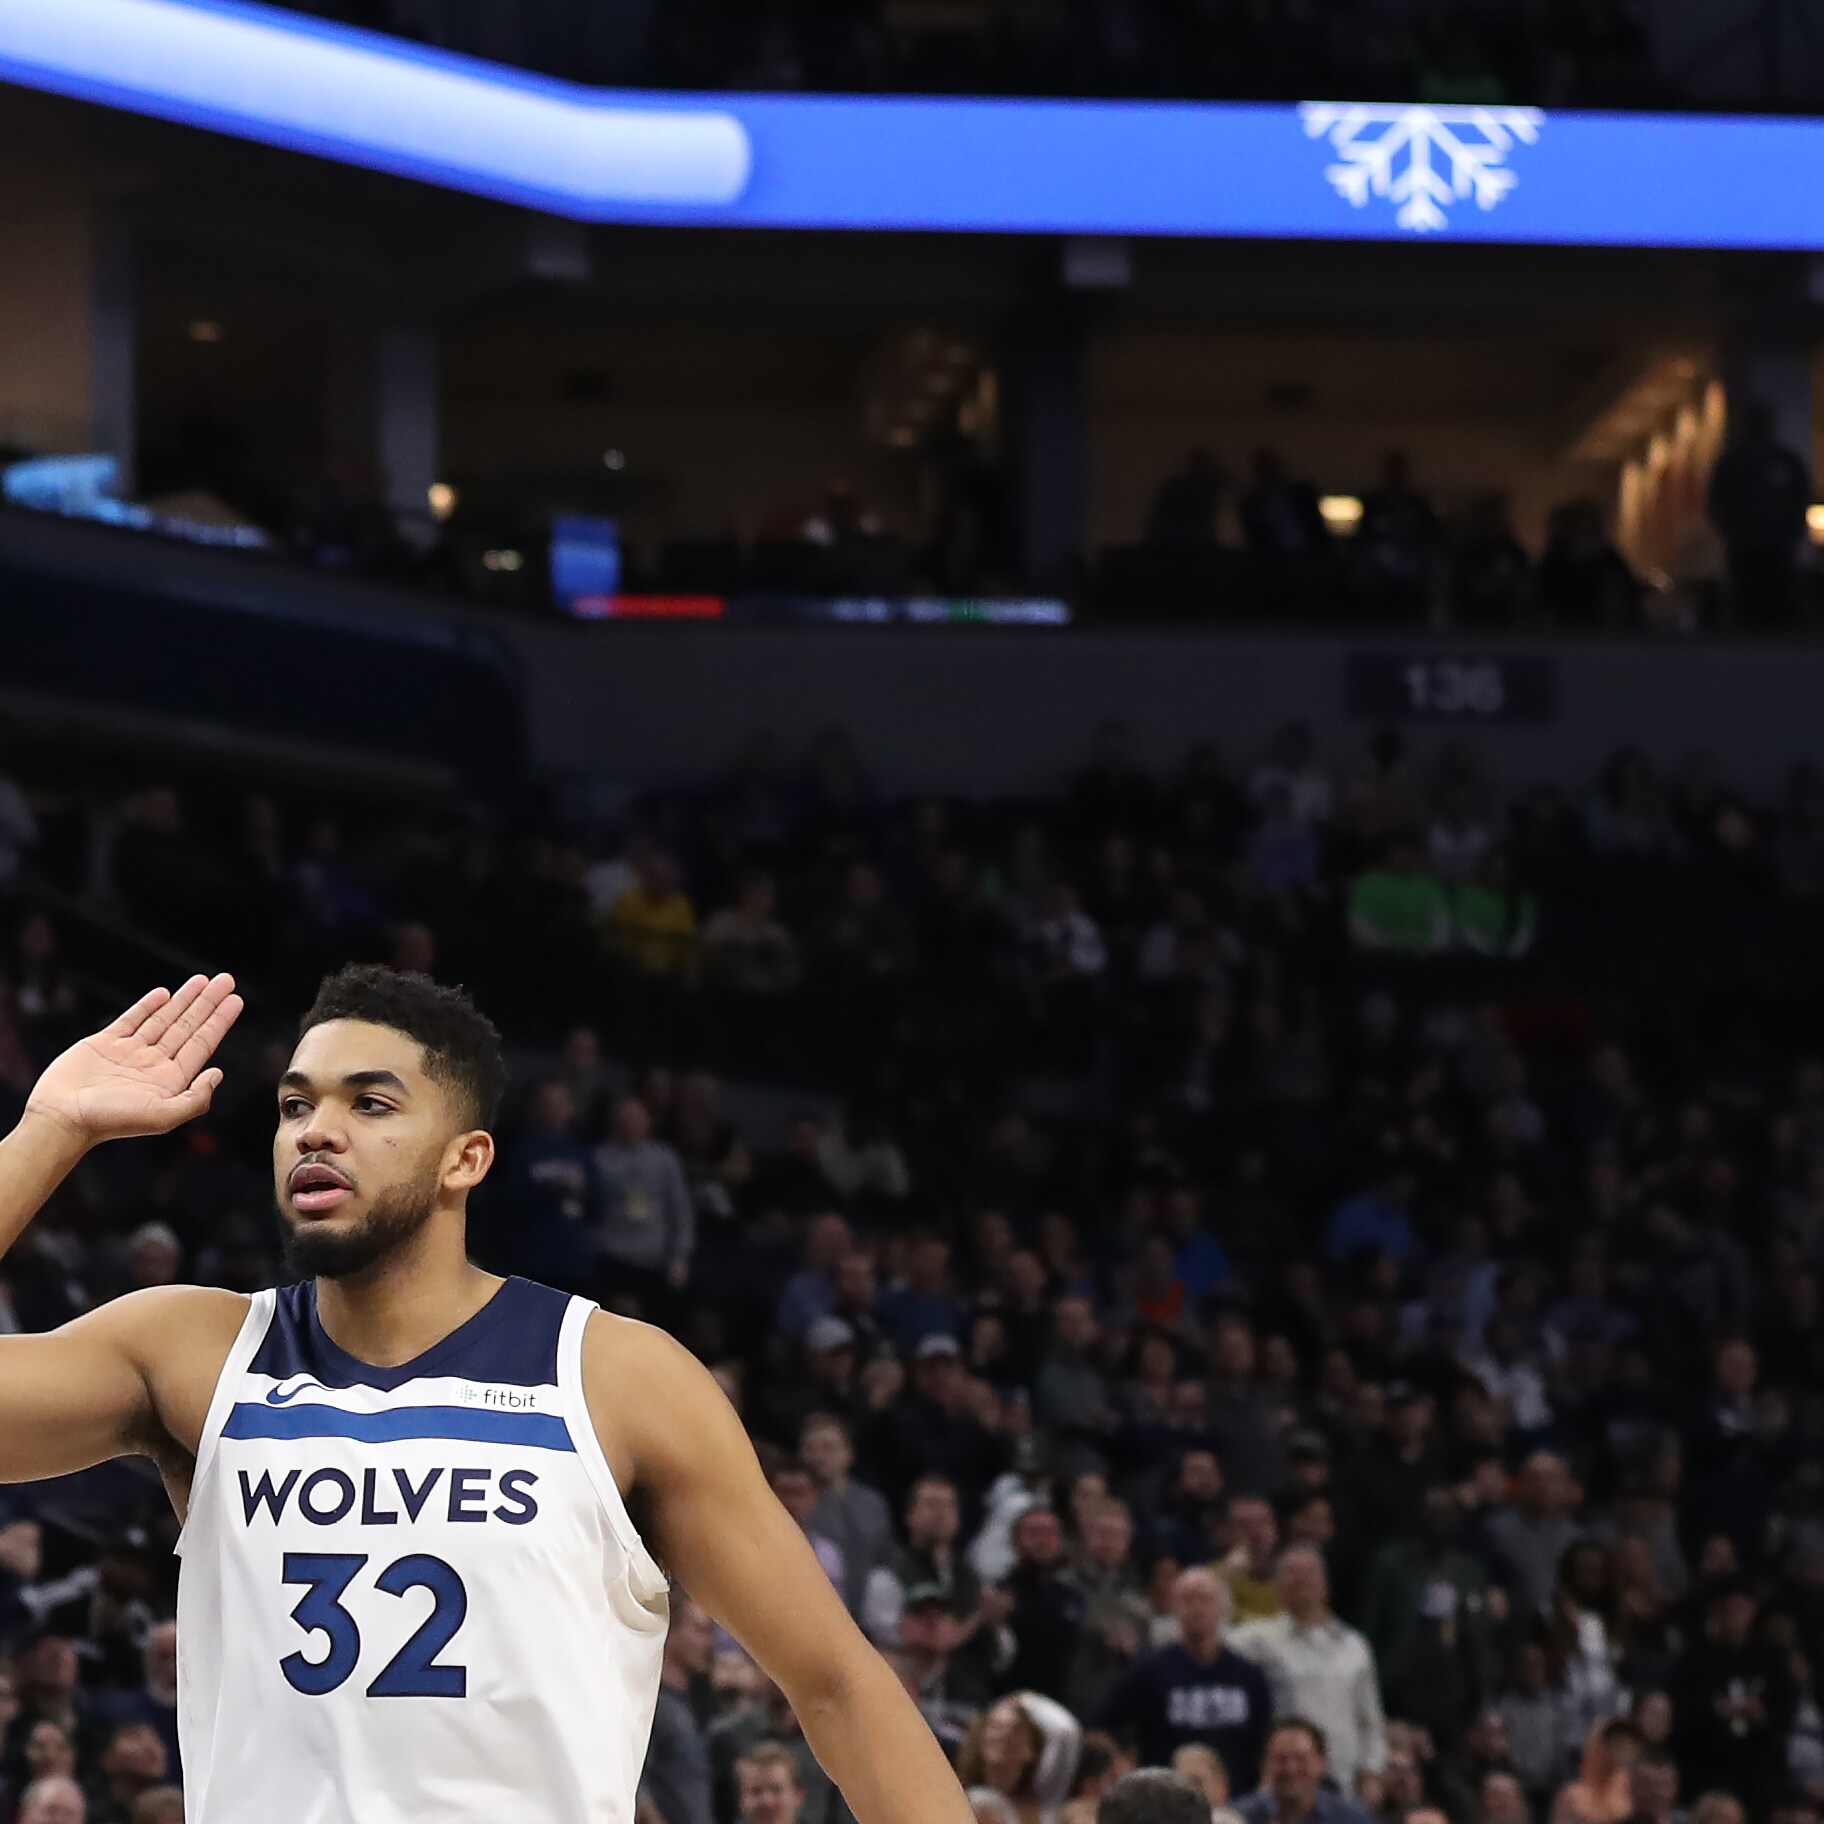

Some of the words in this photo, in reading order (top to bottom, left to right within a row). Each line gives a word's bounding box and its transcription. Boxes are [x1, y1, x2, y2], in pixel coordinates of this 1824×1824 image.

[484, 1389, 536, 1408] fitbit
[237, 1467, 540, 1528] WOLVES
[279, 1552, 467, 1697] 32
